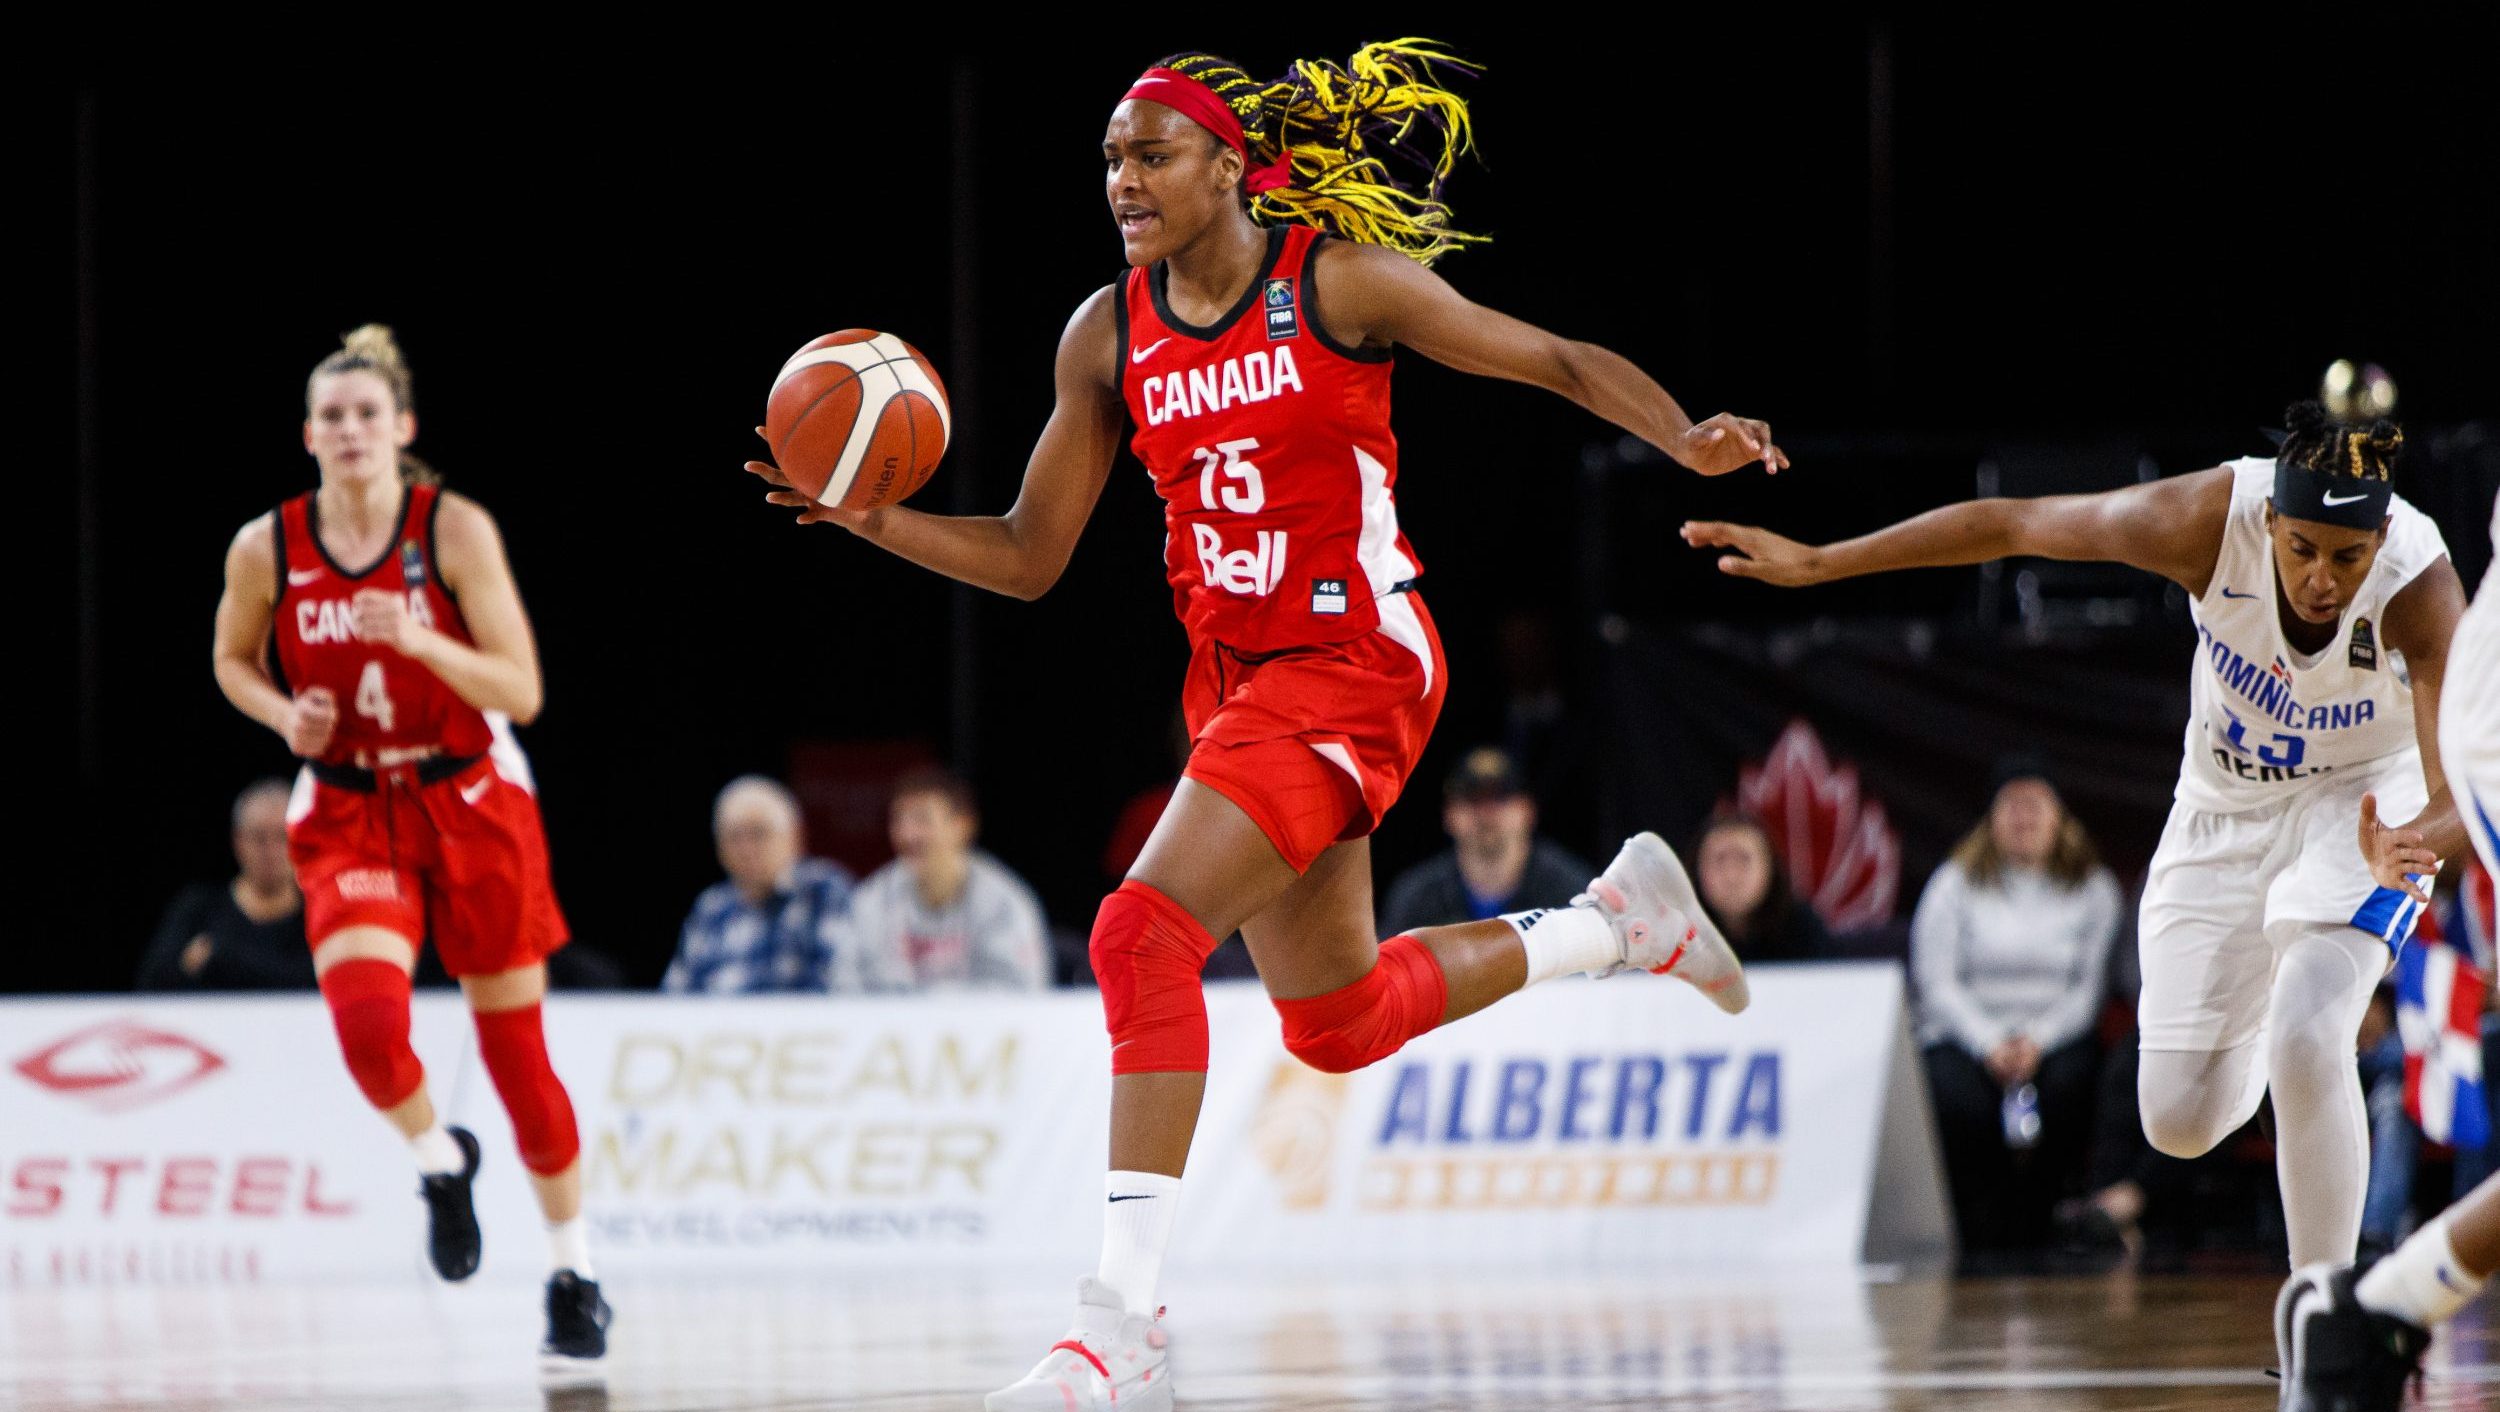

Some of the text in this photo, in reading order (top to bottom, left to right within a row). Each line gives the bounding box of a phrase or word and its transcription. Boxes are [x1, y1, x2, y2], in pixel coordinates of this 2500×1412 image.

[1270, 310, 1293, 324] FIBA
[1143, 345, 1303, 427] CANADA
[1192, 437, 1265, 514] 15
[1192, 522, 1288, 596] Bell
[1319, 582, 1340, 594] 46
[296, 587, 435, 644] CANA
[355, 660, 395, 732] 4
[608, 1031, 1021, 1102] DREAM
[1377, 1051, 1785, 1145] ALBERTA
[585, 1122, 998, 1195] MAKER
